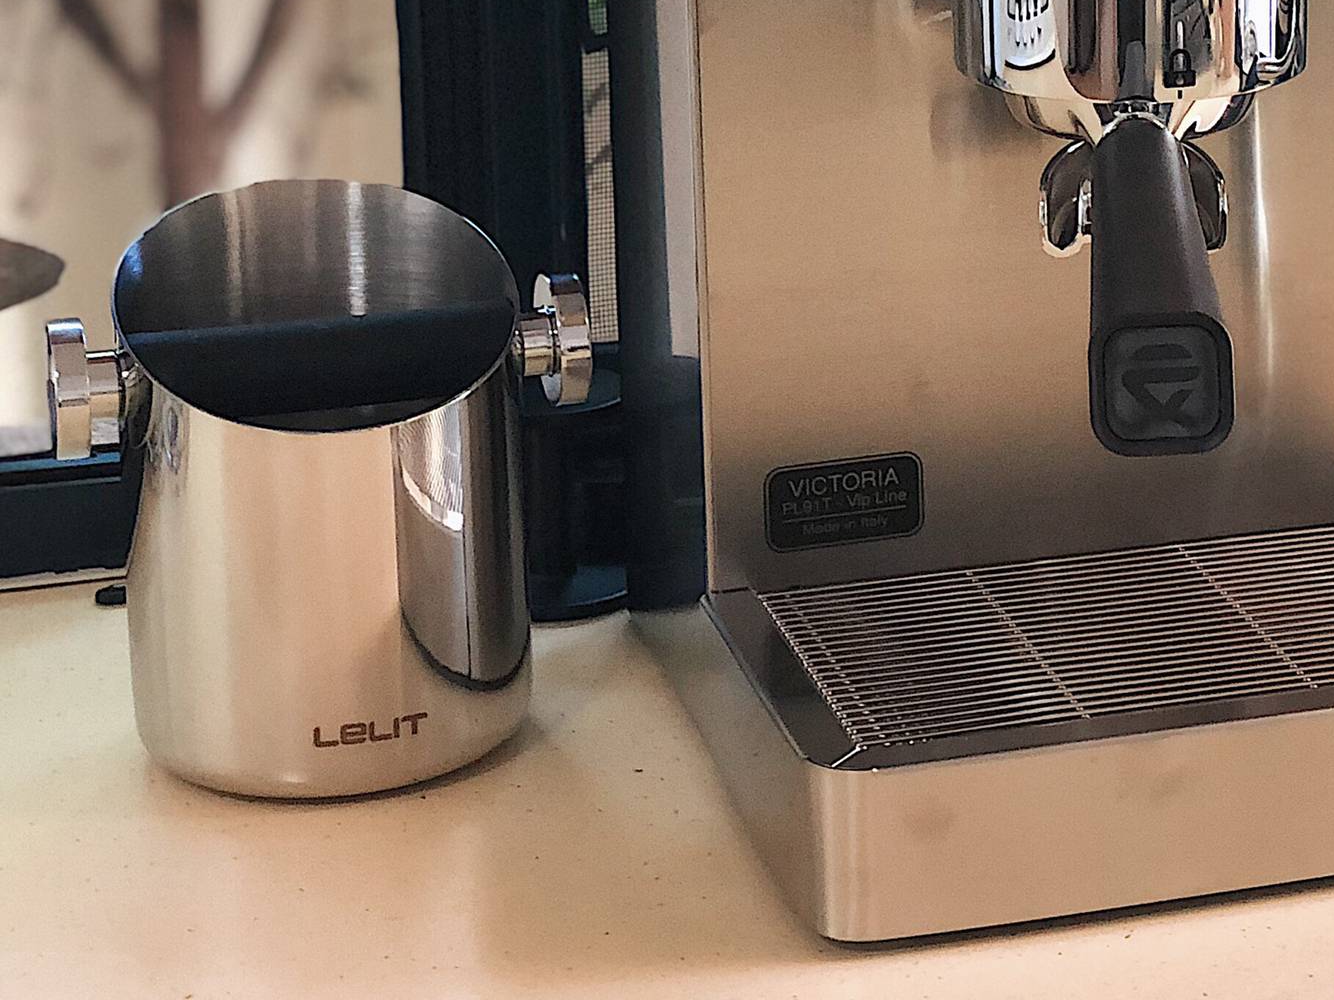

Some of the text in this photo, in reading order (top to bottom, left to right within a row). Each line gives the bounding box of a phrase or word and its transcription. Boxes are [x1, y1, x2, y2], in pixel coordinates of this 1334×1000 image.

[788, 467, 900, 497] VICTORIA
[846, 493, 870, 511] Vip
[874, 489, 908, 506] Line
